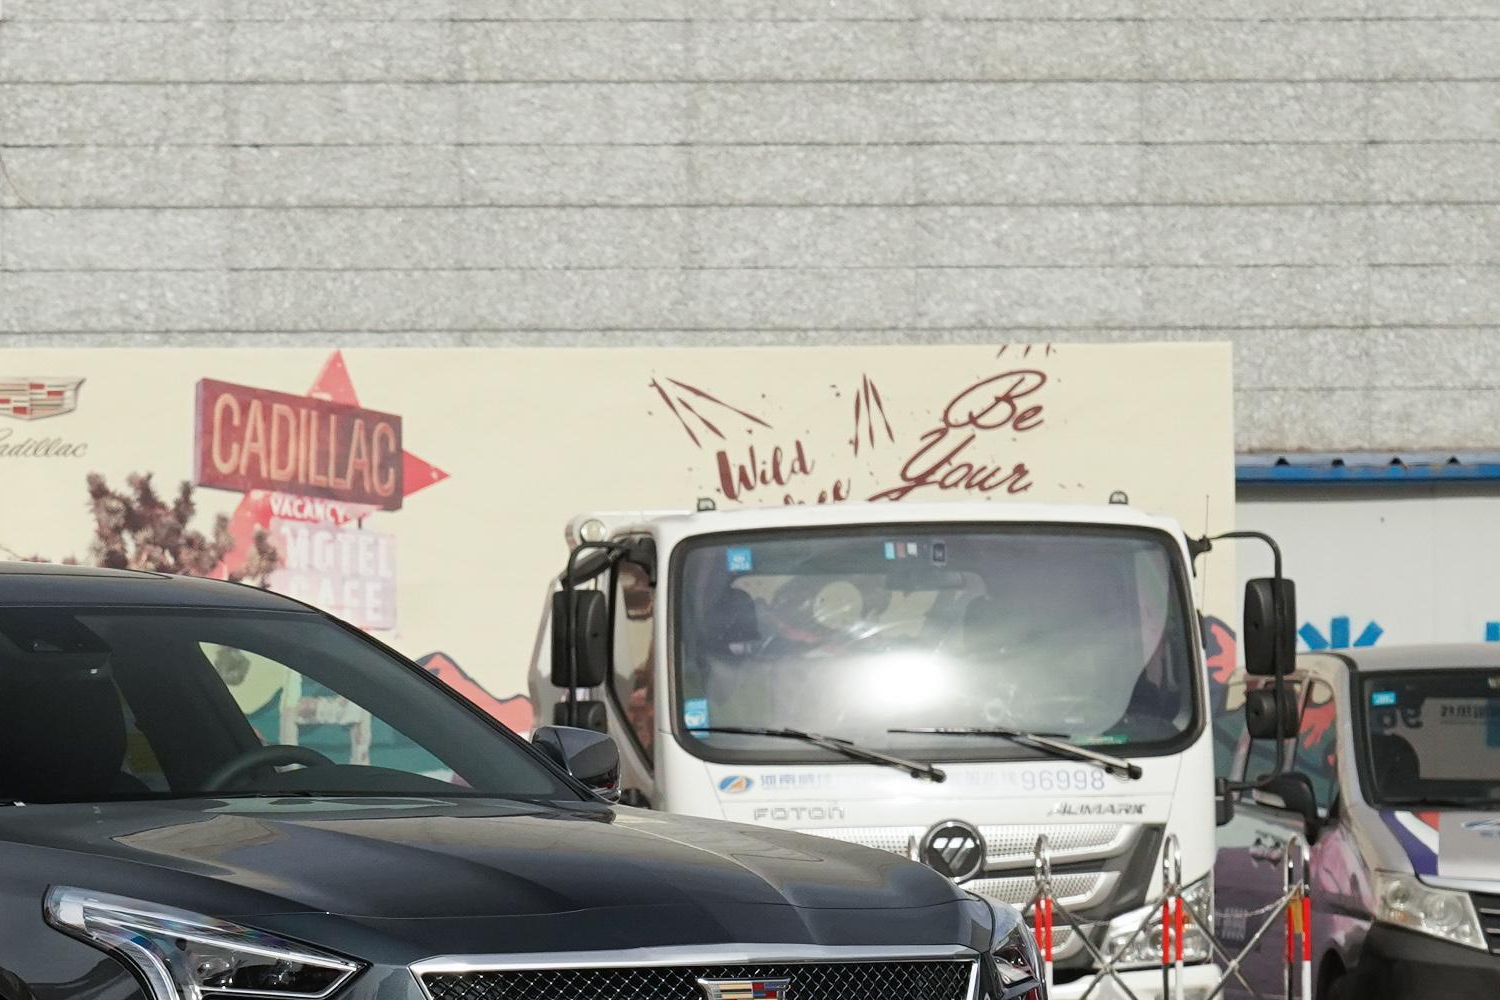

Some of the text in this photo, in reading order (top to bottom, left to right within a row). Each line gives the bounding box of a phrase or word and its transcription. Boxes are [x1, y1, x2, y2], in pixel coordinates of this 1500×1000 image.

[943, 369, 1047, 432] Be
[211, 392, 397, 498] CADILLAC
[716, 439, 815, 503] Wild
[866, 426, 1033, 500] Your
[281, 524, 393, 578] MOTEL
[1021, 768, 1105, 791] 96998
